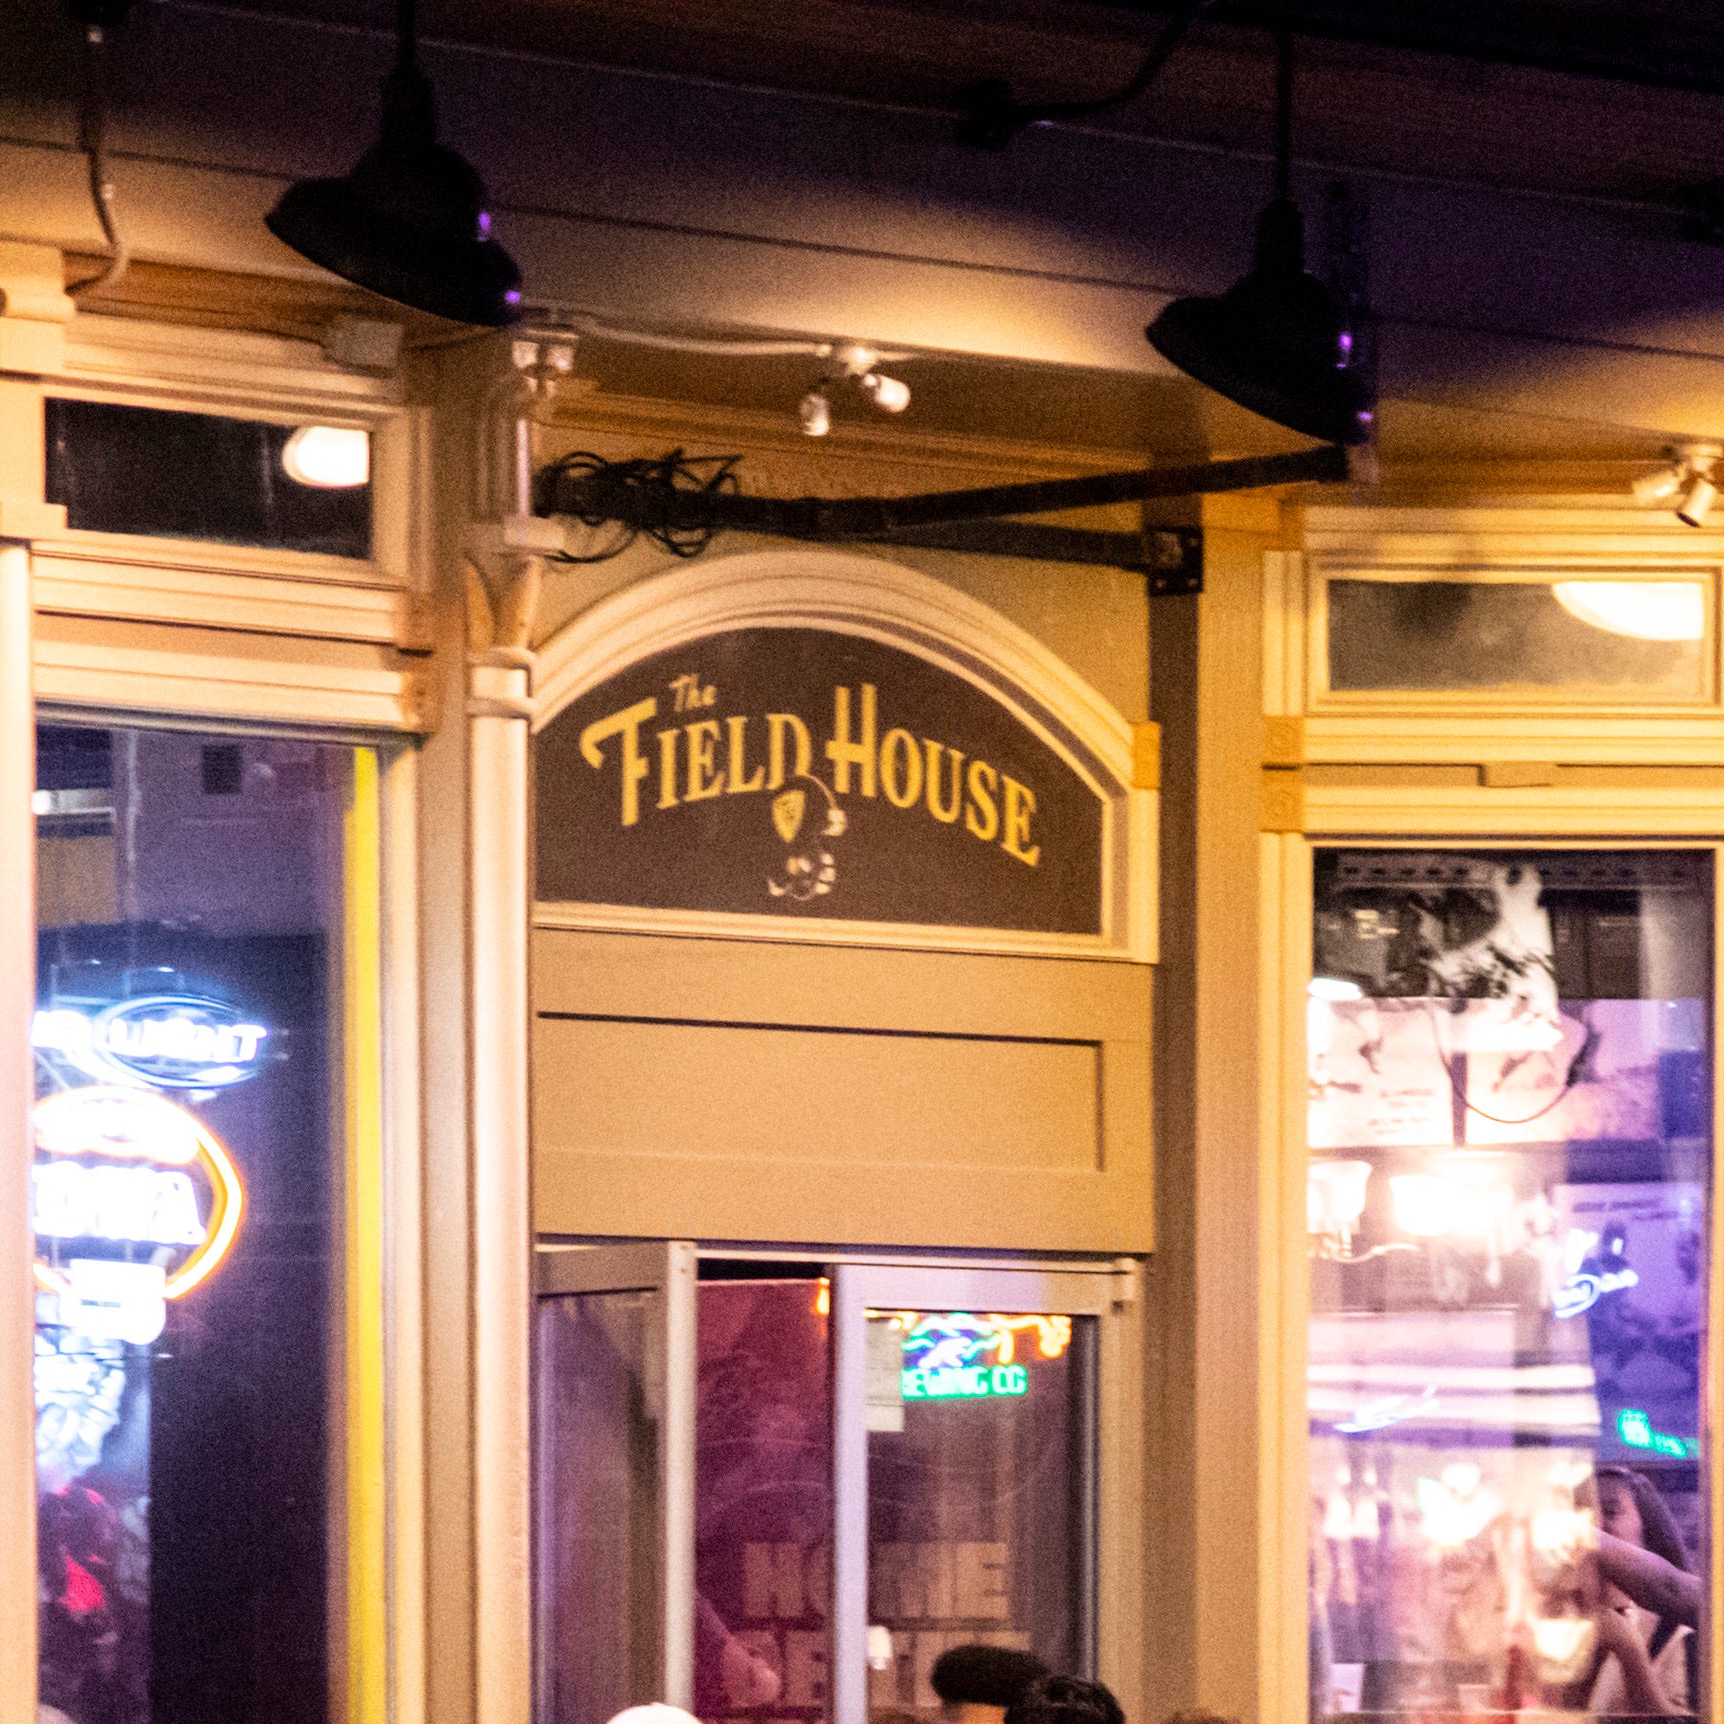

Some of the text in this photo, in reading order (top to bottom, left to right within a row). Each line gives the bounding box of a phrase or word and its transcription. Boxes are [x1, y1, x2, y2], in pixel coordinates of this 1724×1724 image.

[670, 673, 716, 712] The
[579, 683, 1040, 867] FIELD HOUSE
